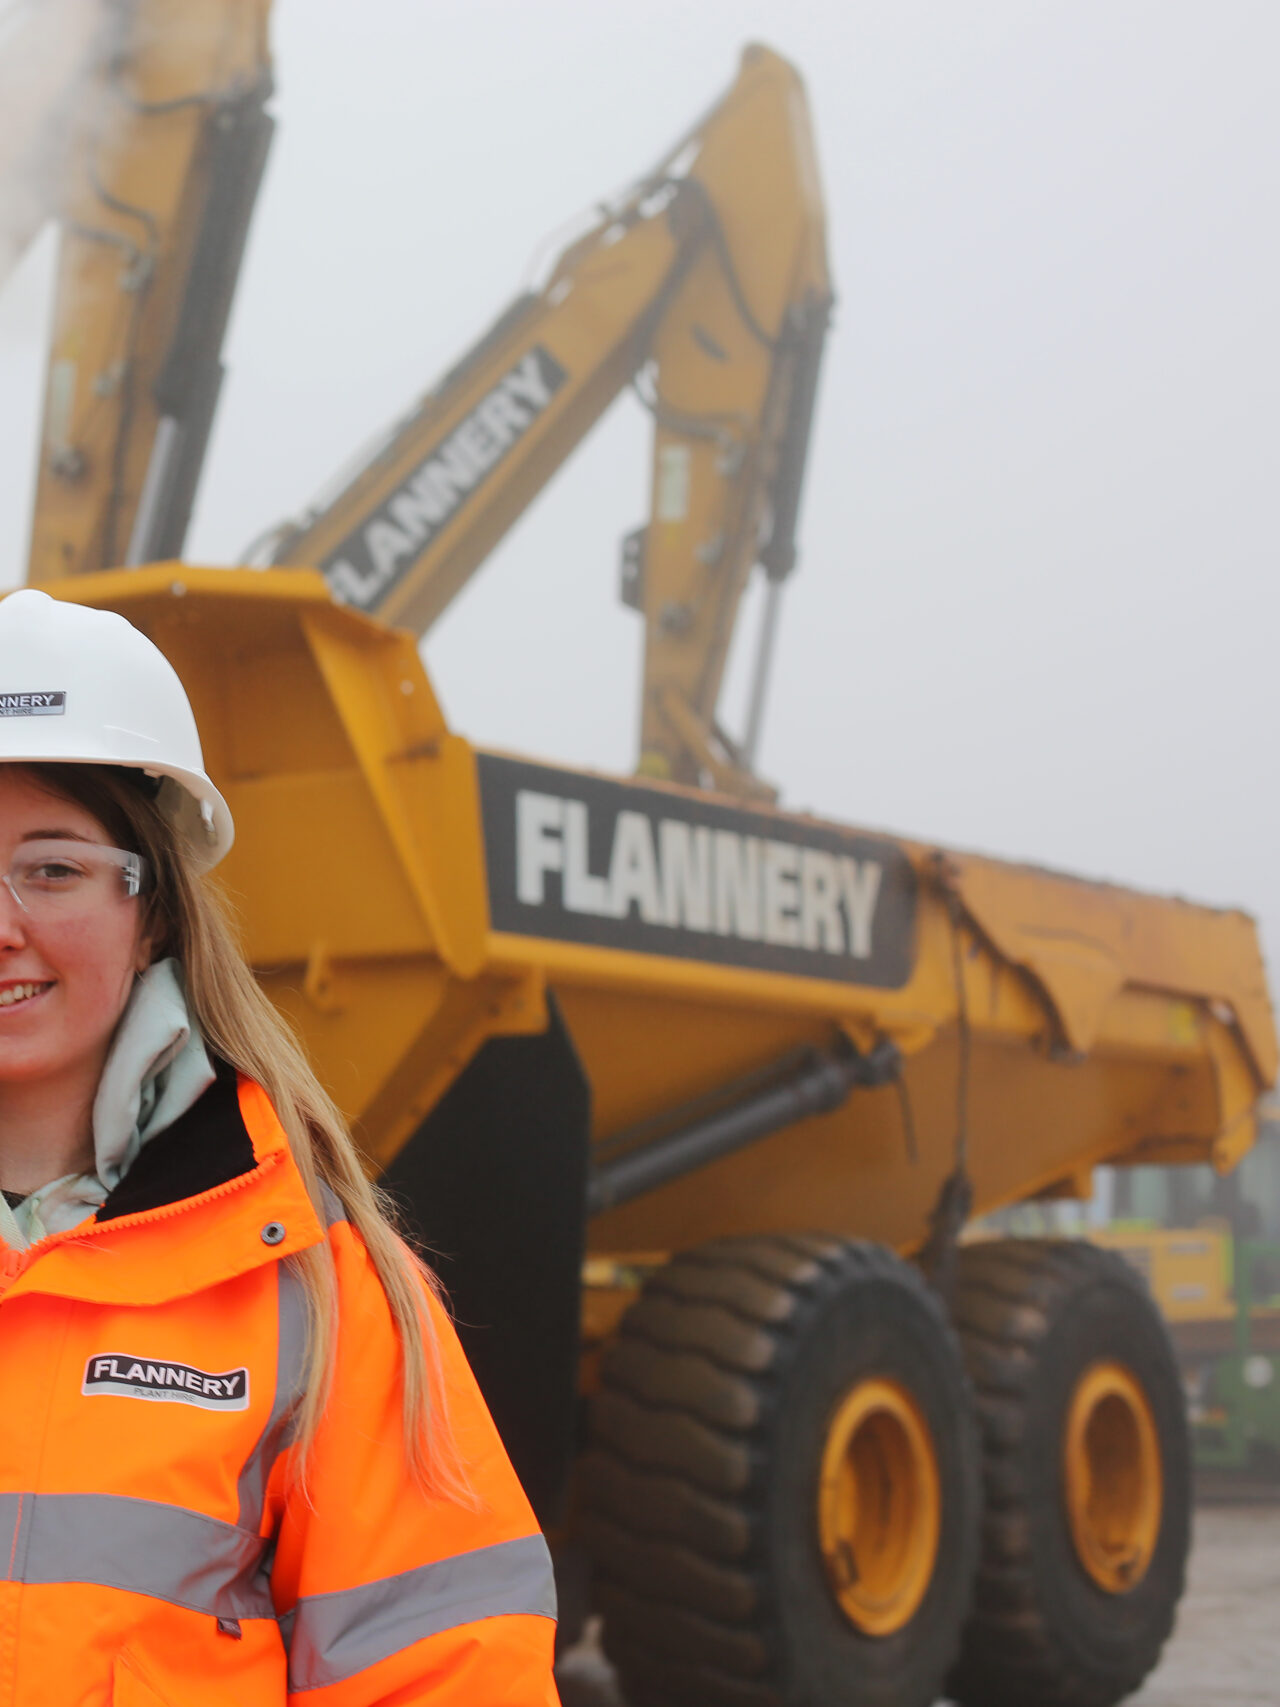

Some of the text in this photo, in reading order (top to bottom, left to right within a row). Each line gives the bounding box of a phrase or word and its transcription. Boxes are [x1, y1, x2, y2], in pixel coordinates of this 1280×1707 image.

[516, 789, 882, 959] FLANNERY
[93, 1359, 240, 1396] FLANNERY
[133, 1387, 168, 1400] PLANT
